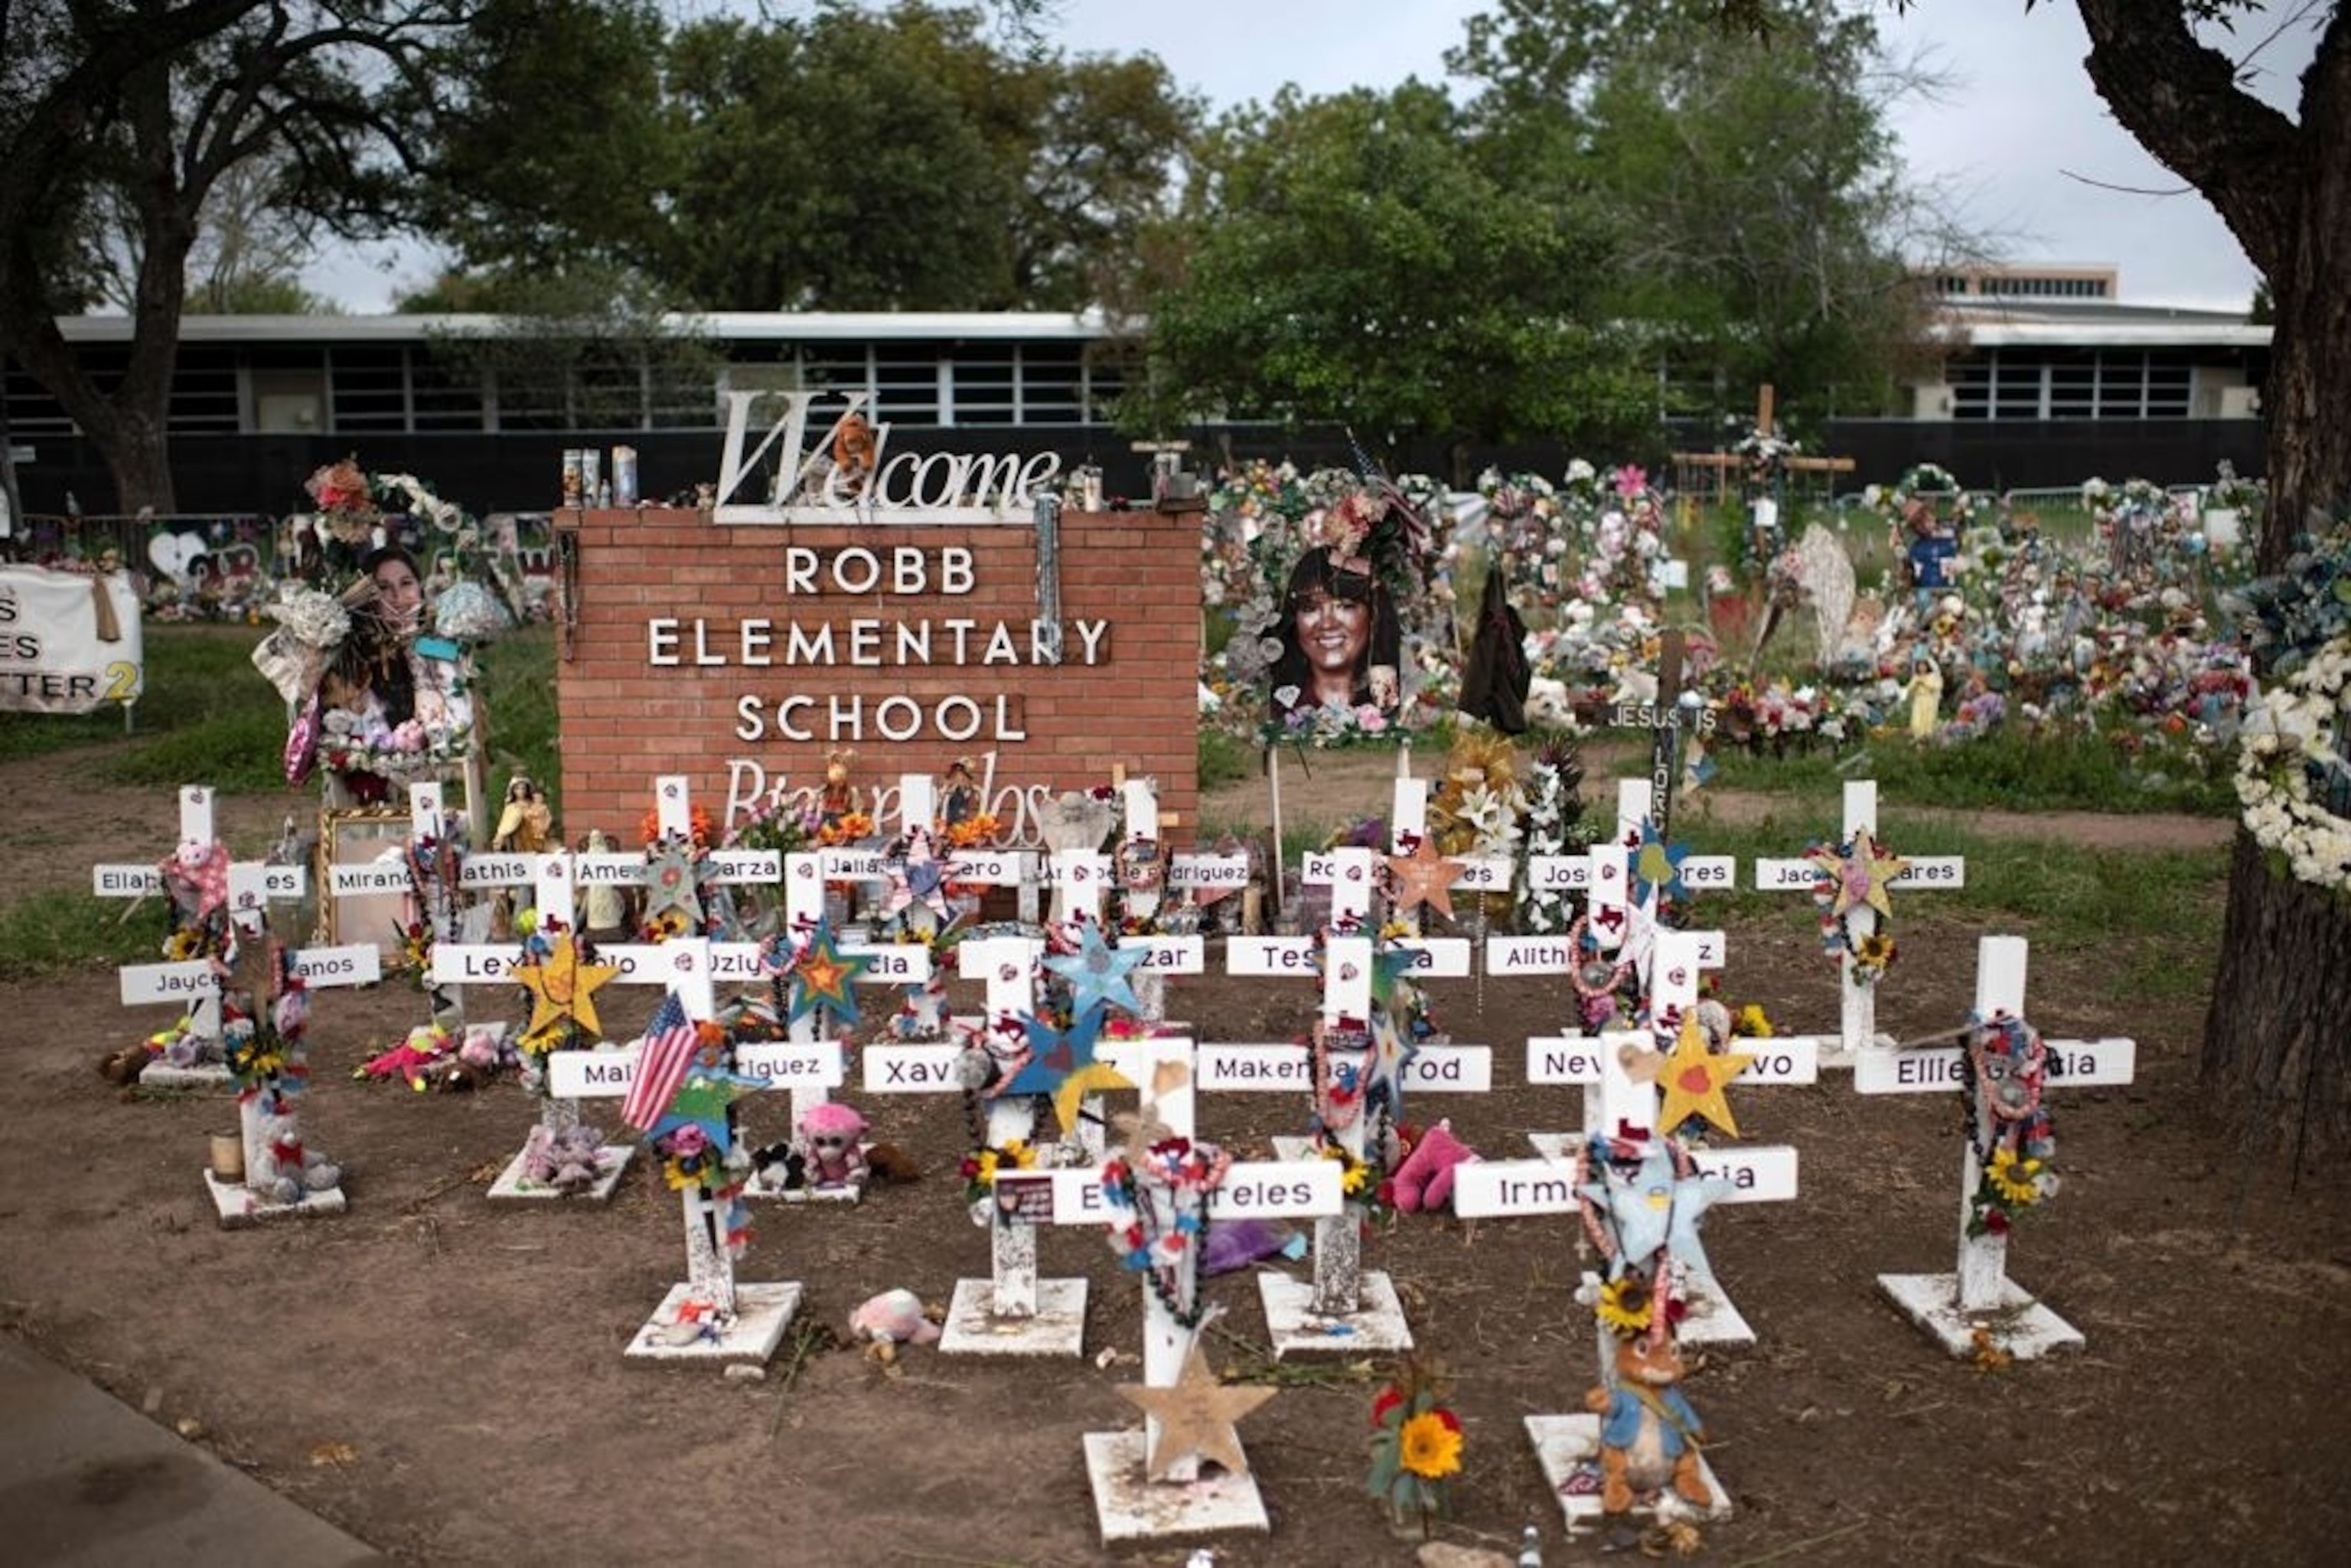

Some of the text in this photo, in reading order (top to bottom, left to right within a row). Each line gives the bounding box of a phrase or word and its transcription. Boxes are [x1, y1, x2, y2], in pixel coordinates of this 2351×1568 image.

[716, 390, 1061, 508] Welcome
[787, 547, 976, 595] ROBB
[649, 619, 1107, 666] ELEMENTARY
[0, 661, 139, 699] TER 2
[735, 695, 1026, 742] SCHOOL
[1608, 706, 1717, 731] JESUS IS
[1653, 745, 1668, 832] LORD
[337, 862, 527, 889] Mirand athis
[580, 861, 777, 880] Ame arza
[1544, 865, 1726, 882] Jos ores
[1899, 864, 1955, 880] ares
[298, 958, 354, 976] anos
[465, 954, 522, 976] Lex
[1262, 946, 1317, 968] Tes
[584, 1063, 632, 1084] Mai
[886, 1060, 951, 1084] Xav
[1215, 1058, 1461, 1080] Makena rod
[1898, 1057, 1965, 1084] Ellie
[1211, 1182, 1312, 1207] reles
[1500, 1178, 1570, 1204] Irm
